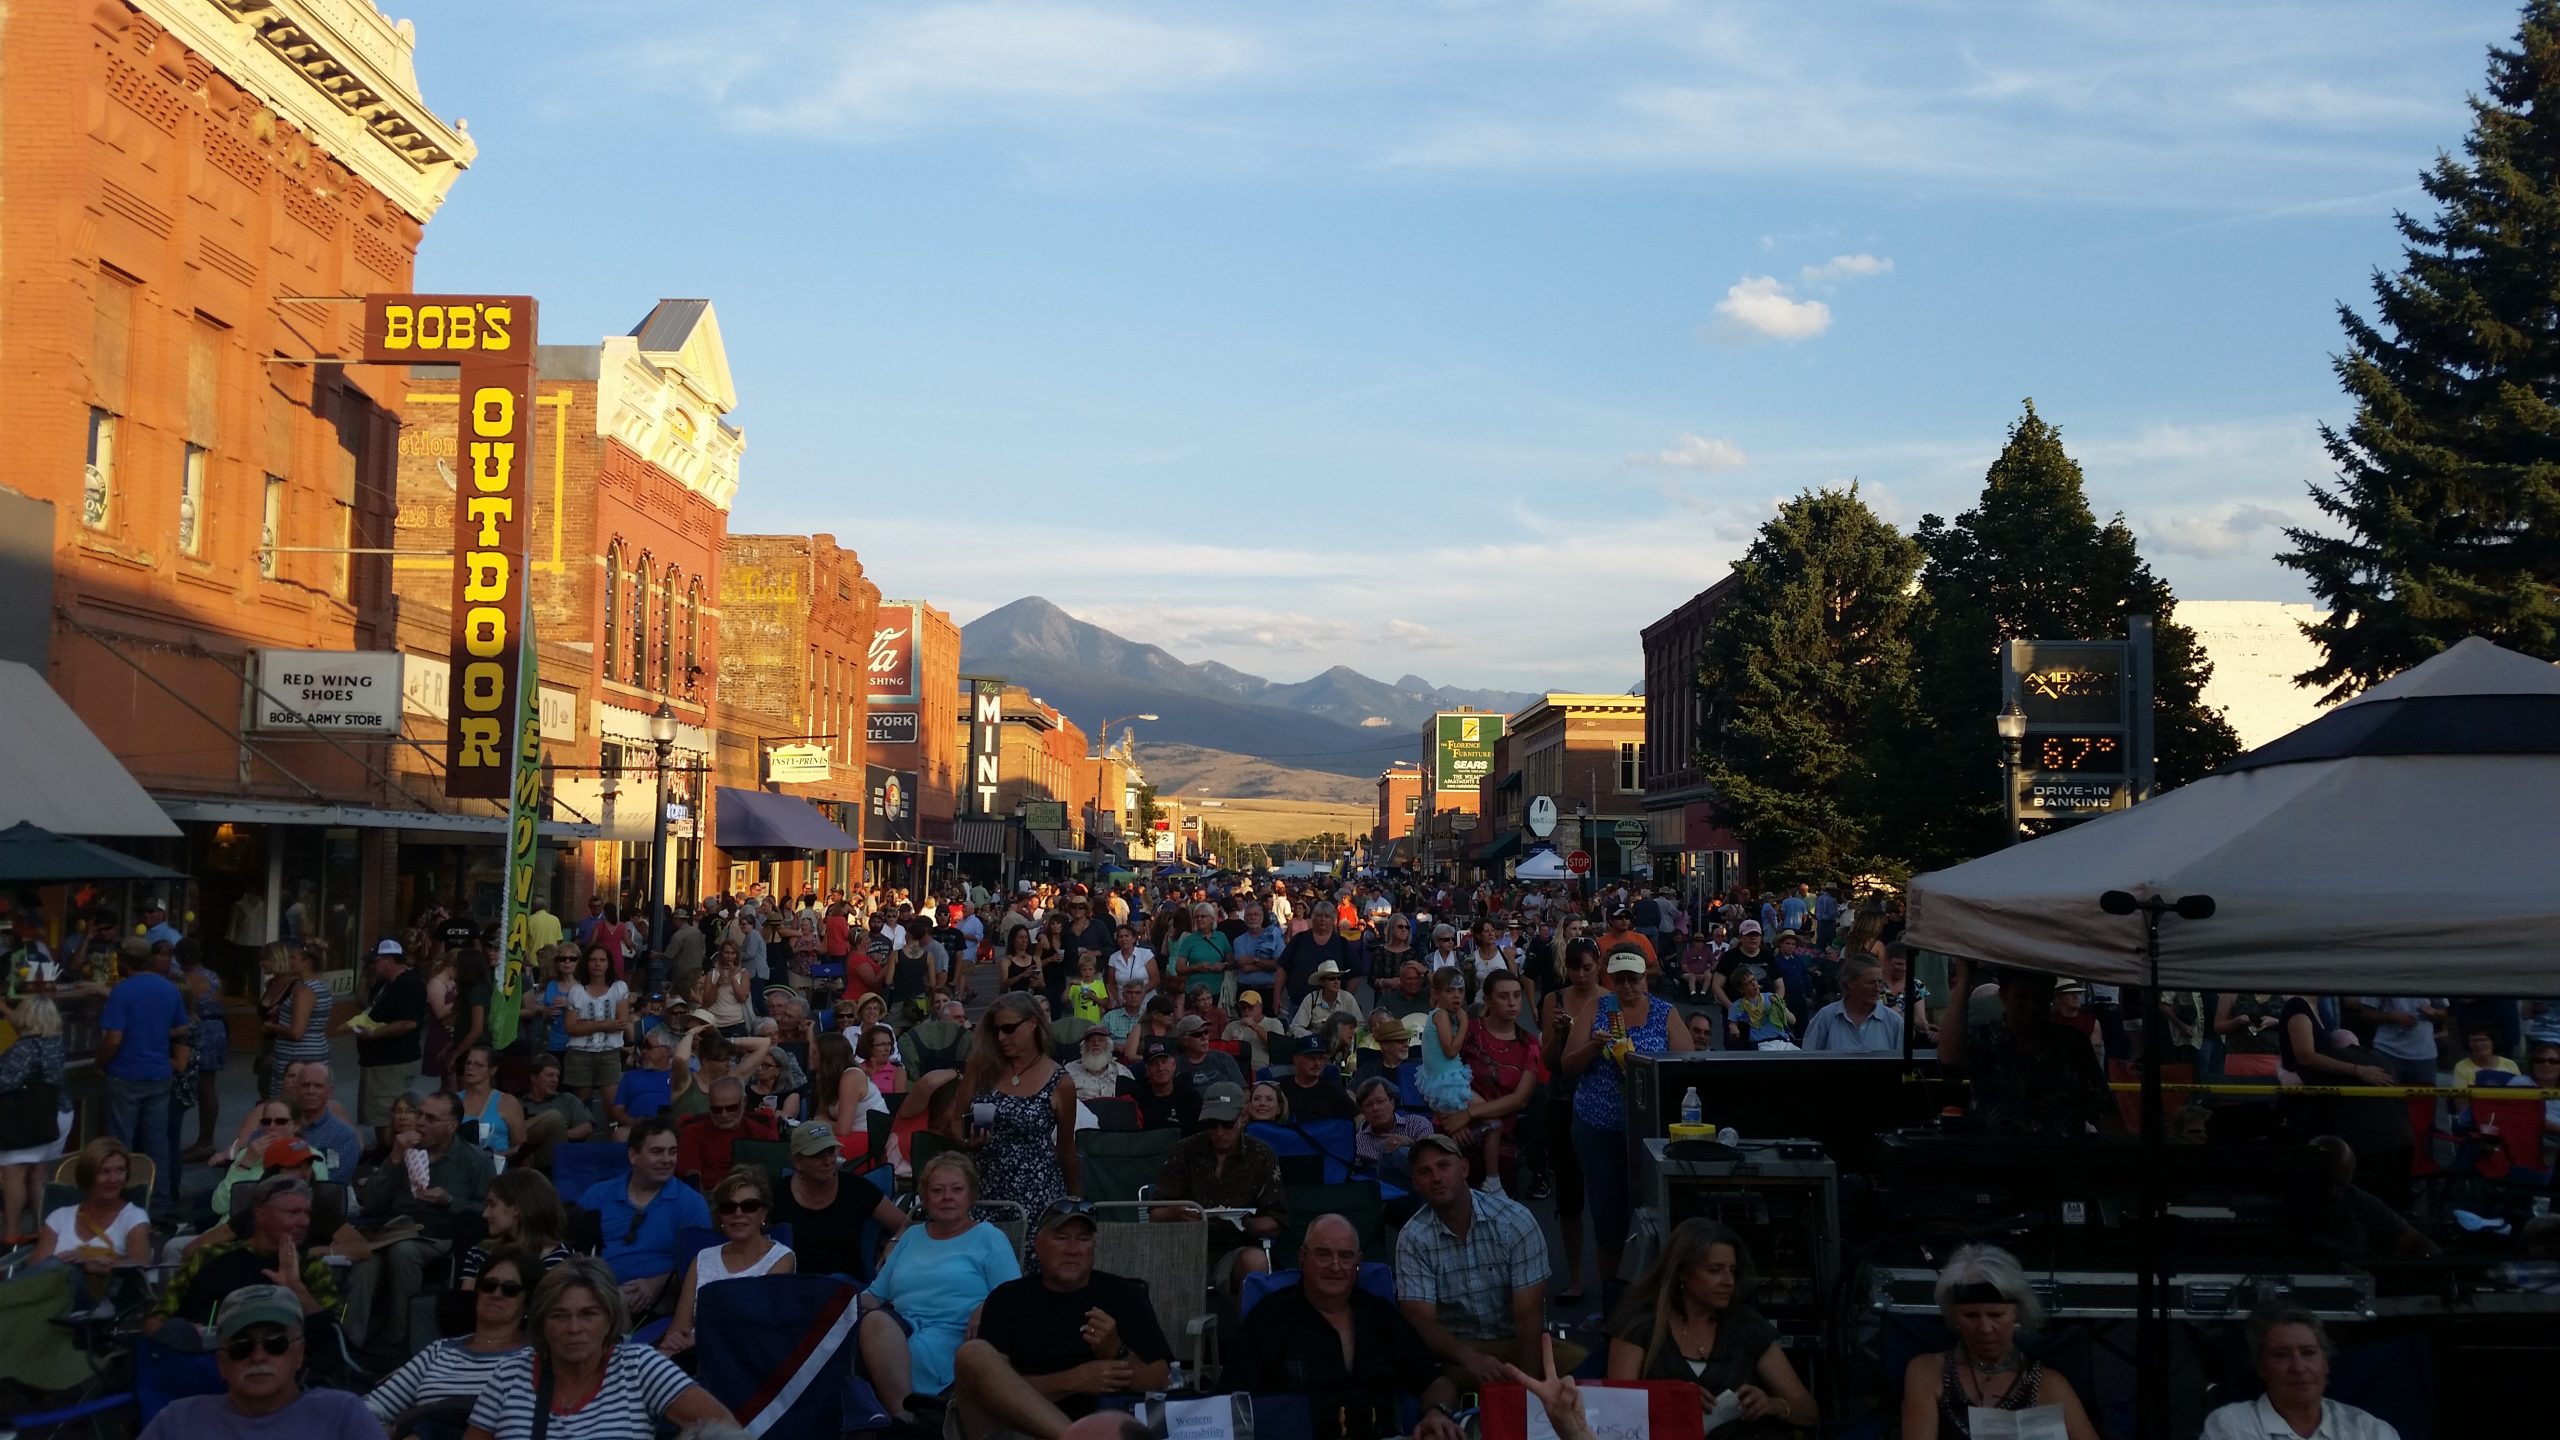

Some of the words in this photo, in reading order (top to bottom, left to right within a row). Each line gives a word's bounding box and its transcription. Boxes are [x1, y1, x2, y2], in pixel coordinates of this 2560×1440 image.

[384, 303, 512, 350] BOB'S
[458, 387, 515, 768] OUTDOOR
[283, 673, 314, 686] RED
[322, 675, 373, 688] WING
[302, 689, 354, 702] SHOES
[307, 713, 342, 725] ARMY
[344, 714, 383, 726] STORE
[873, 716, 913, 727] YORK
[1447, 740, 1481, 750] FLORENCE
[977, 694, 1001, 813] MINT
[1452, 749, 1492, 759] FURNITURE
[772, 757, 828, 766] INSTY-PRINTS
[1453, 761, 1488, 770] SEARS
[2033, 786, 2111, 796] DRIVE-IN
[2033, 797, 2111, 807] BANKING
[1569, 858, 1590, 867] STOP
[1311, 1037, 1319, 1048] S
[1175, 1416, 1212, 1425] Western
[1168, 1427, 1224, 1440] ustainability
